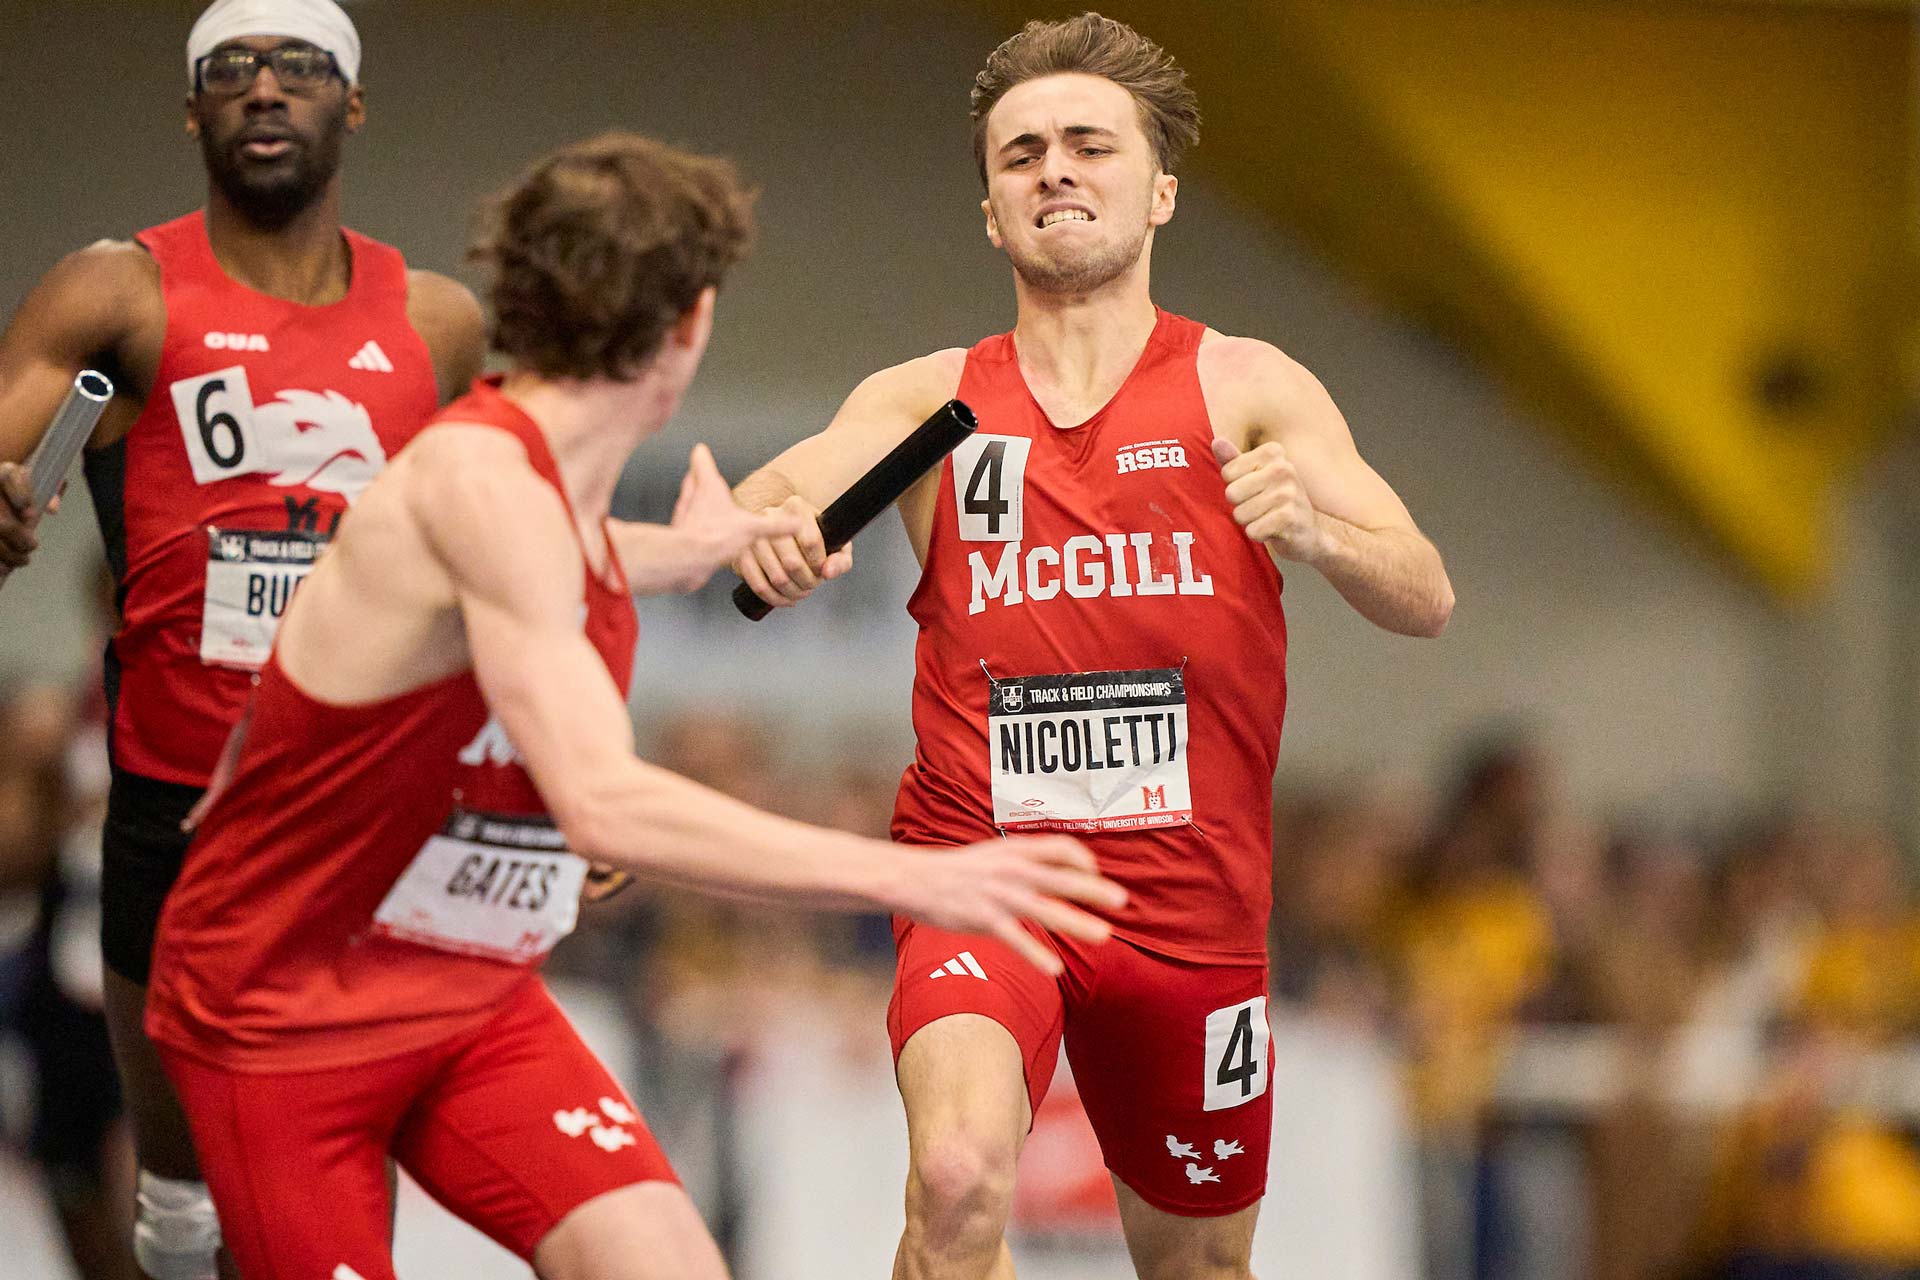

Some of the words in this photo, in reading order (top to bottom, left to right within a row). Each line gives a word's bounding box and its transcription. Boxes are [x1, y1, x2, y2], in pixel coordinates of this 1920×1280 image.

[204, 332, 270, 352] OUA
[196, 379, 245, 469] 6
[964, 440, 1009, 535] 4
[1116, 446, 1189, 475] RSEQ
[1029, 688, 1061, 704] TRACK
[1062, 687, 1069, 702] &
[1070, 685, 1095, 701] FIELD
[1096, 682, 1172, 700] CHAMPIONSHIPS
[1000, 712, 1177, 775] NICOLETTI
[1103, 818, 1138, 829] UNIVERSITY
[1138, 816, 1147, 826] OF
[1147, 814, 1174, 825] WINDSOR
[446, 854, 558, 910] GATES
[1217, 1006, 1258, 1098] 4
